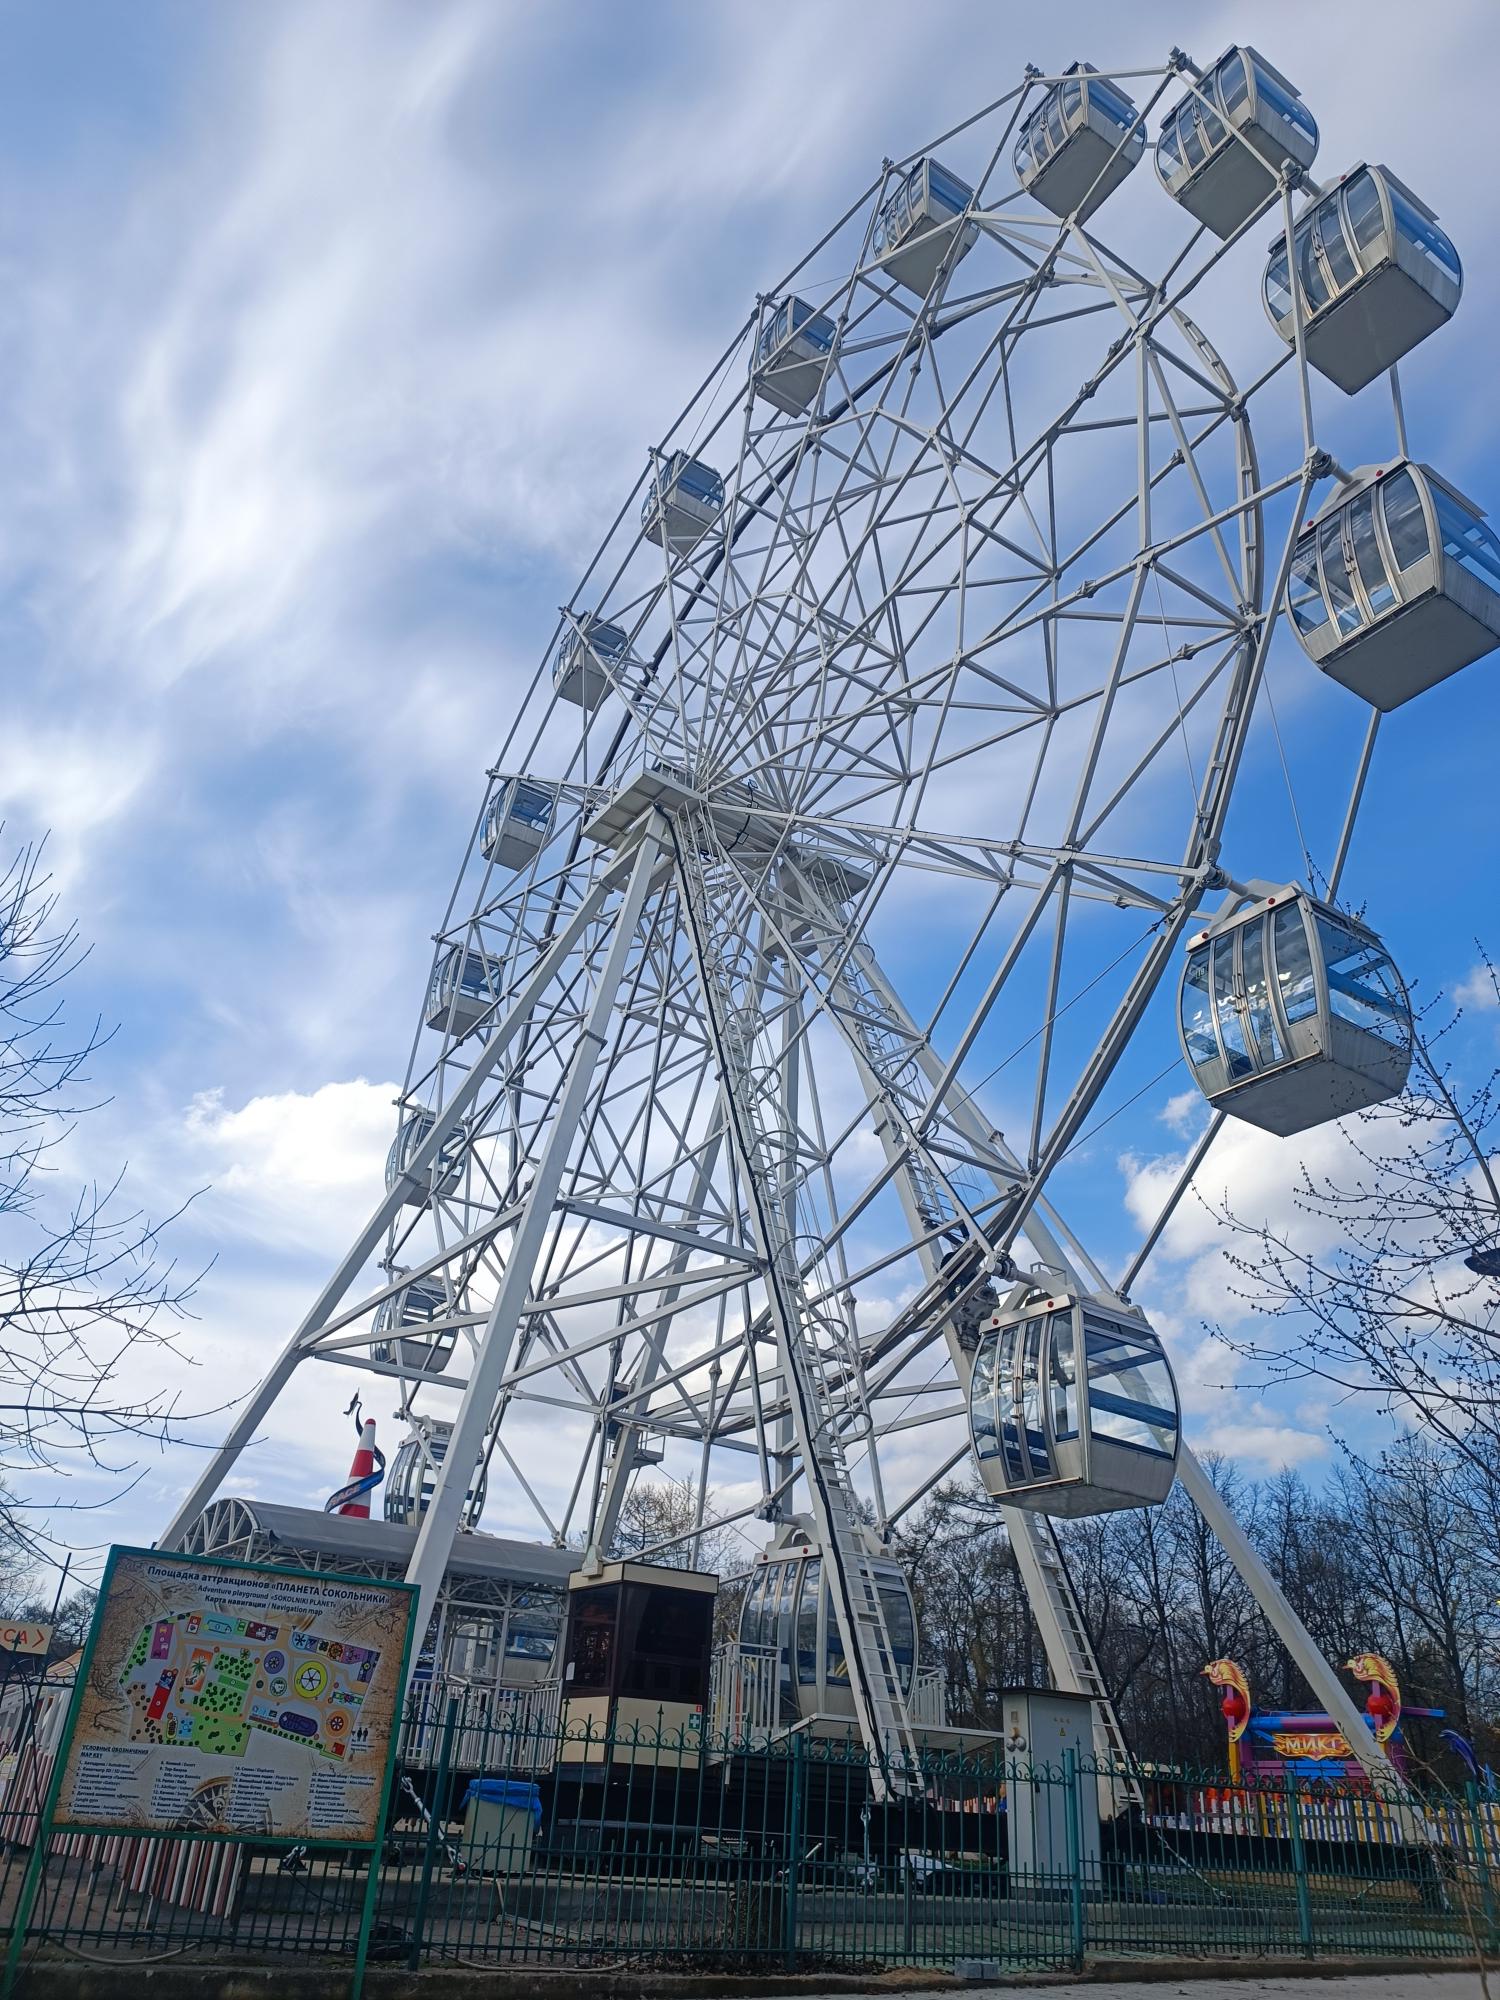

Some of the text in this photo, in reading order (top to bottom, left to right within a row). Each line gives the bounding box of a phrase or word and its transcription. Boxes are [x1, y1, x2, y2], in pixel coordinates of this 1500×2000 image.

[148, 1566, 199, 1580] Площадка
[201, 1574, 269, 1589] аттракционов
[271, 1582, 320, 1596] «ПЛАНЕТА
[198, 1585, 231, 1595] Adventure
[232, 1589, 269, 1600] playground
[205, 1595, 226, 1605] Карта
[228, 1598, 266, 1609] навигации
[271, 1603, 307, 1613] Navigation
[308, 1608, 323, 1616] map
